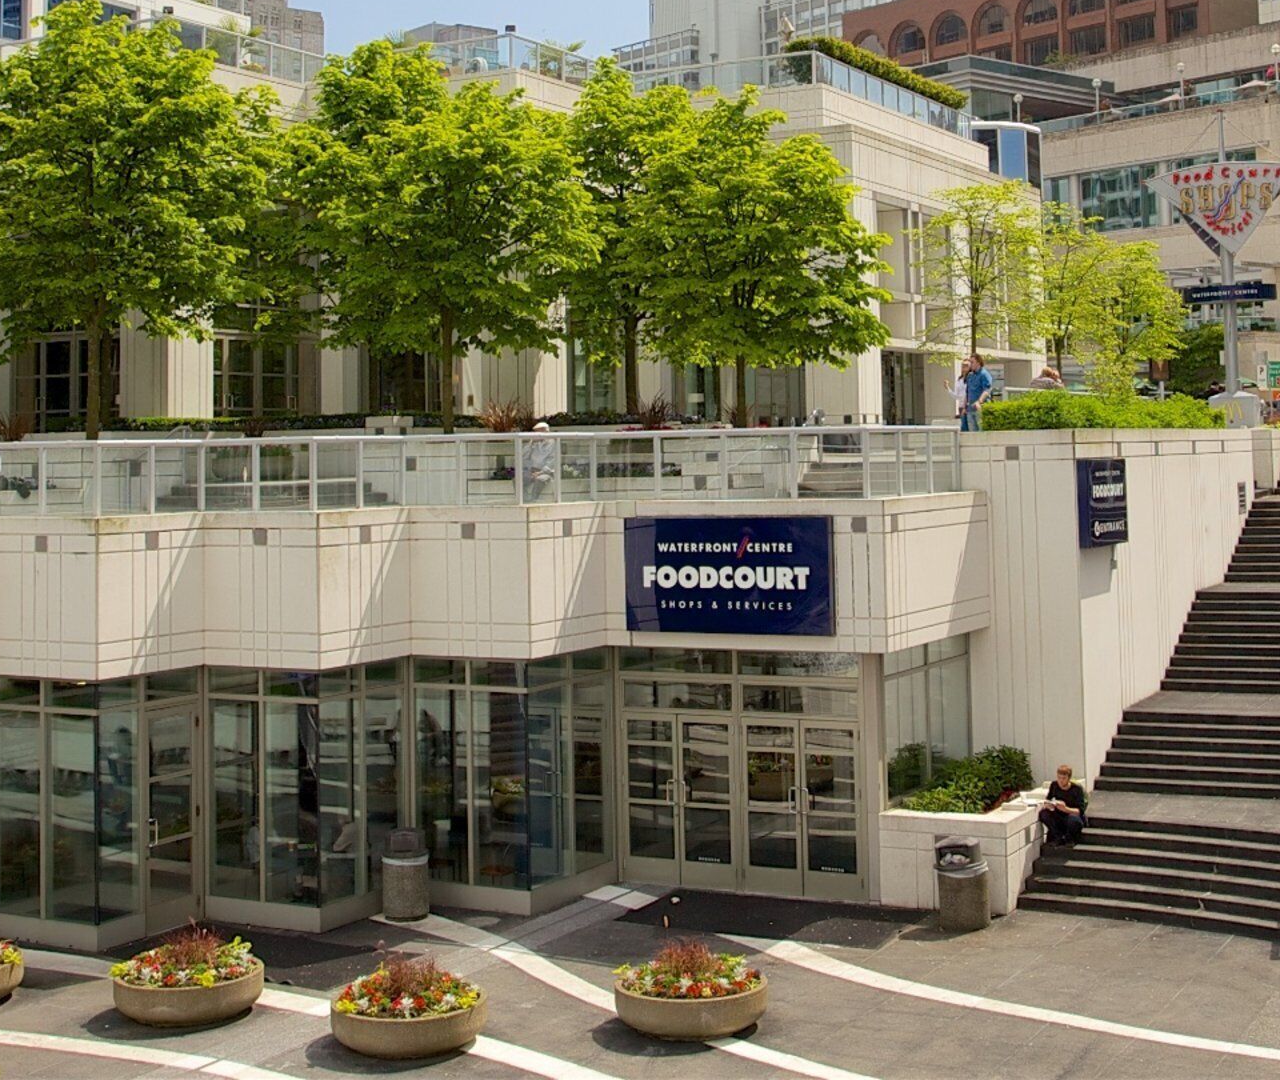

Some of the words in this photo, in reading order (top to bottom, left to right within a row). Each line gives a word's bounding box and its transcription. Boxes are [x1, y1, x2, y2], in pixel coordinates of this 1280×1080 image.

[1180, 181, 1274, 221] SHOPS
[1191, 289, 1231, 299] WATERFRONT
[1234, 288, 1258, 296] CENTRE
[1092, 483, 1123, 498] FOODCOURT
[657, 542, 738, 553] WATERFRONT
[746, 542, 793, 553] CENTRE
[643, 565, 810, 590] FOODCOURT
[660, 600, 702, 609] SHOPS
[711, 601, 718, 609] &
[727, 600, 793, 611] SERVICES
